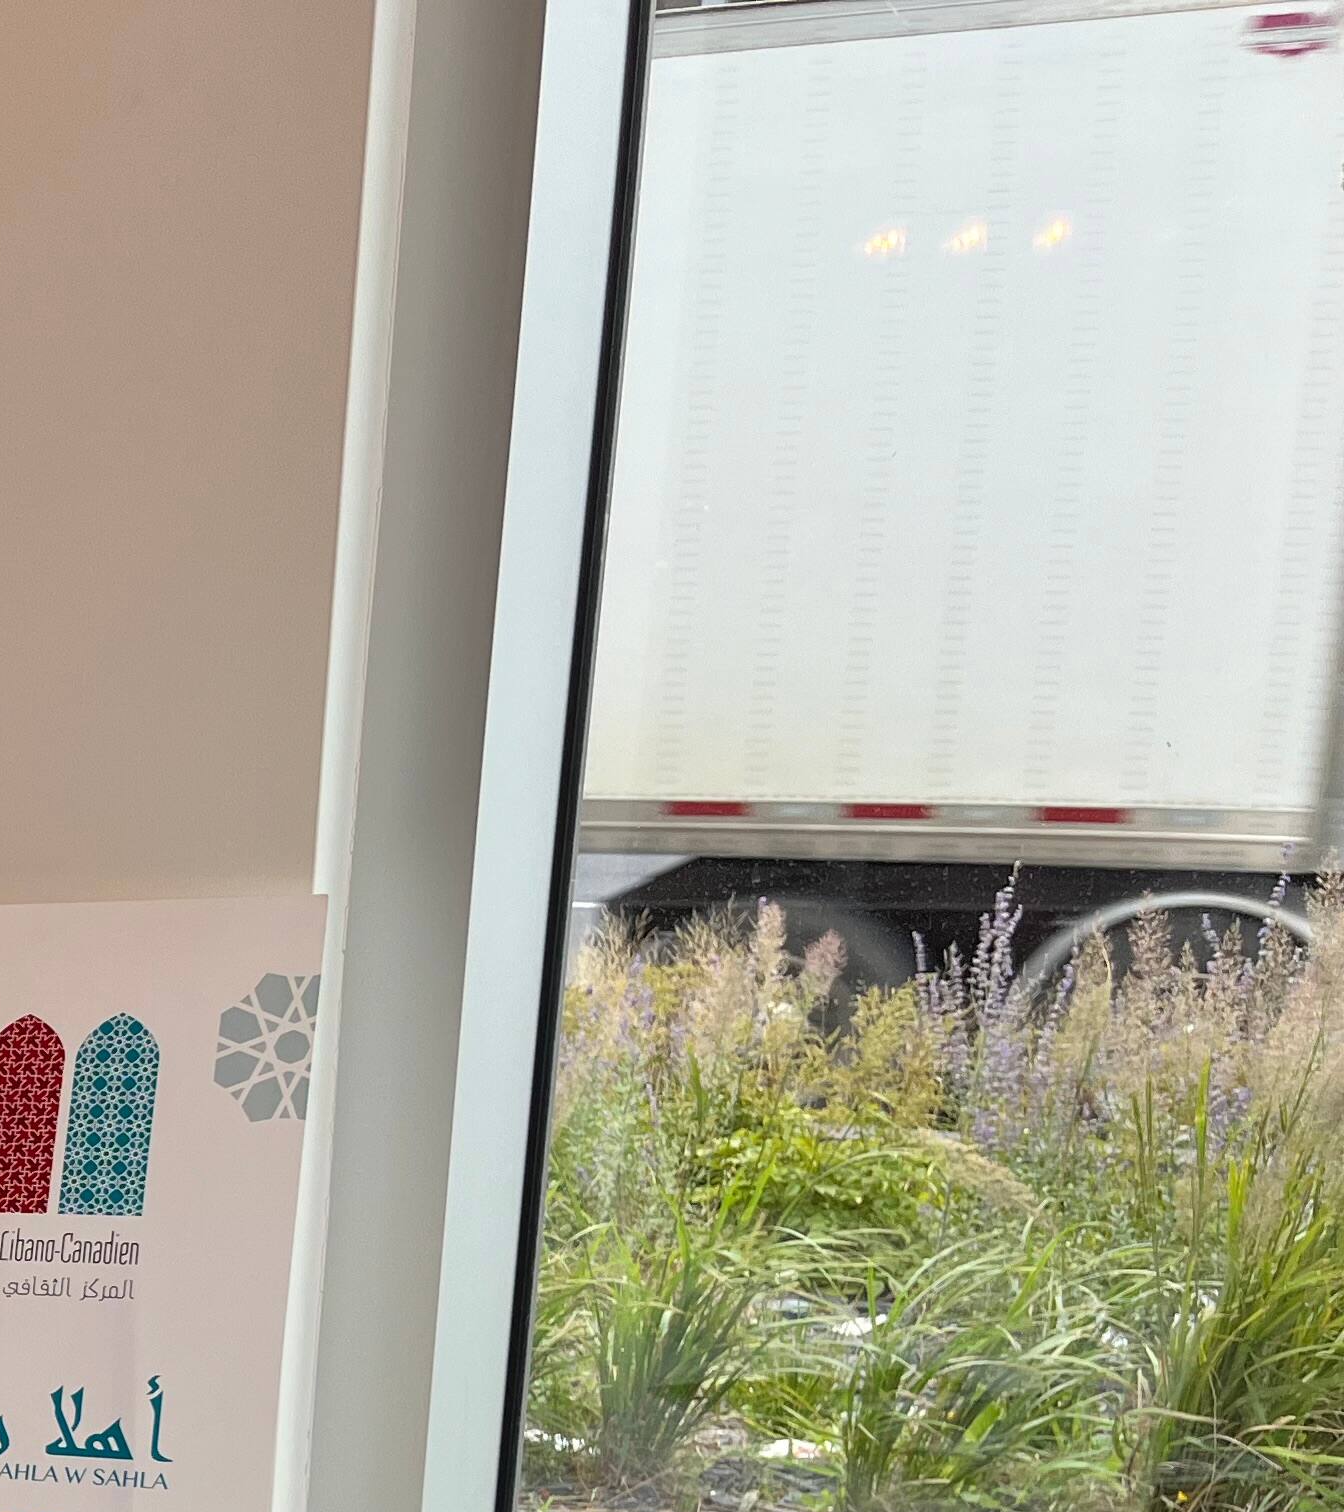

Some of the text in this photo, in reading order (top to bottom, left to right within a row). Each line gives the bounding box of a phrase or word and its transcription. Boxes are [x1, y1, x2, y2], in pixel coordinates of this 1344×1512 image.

[0, 1229, 140, 1265] Libano-Canadien
[2, 1276, 72, 1298] الثقافي
[80, 1278, 135, 1301] المركز
[45, 1375, 173, 1462] أهلا
[65, 1467, 88, 1485] W
[93, 1468, 169, 1490] SAHLA
